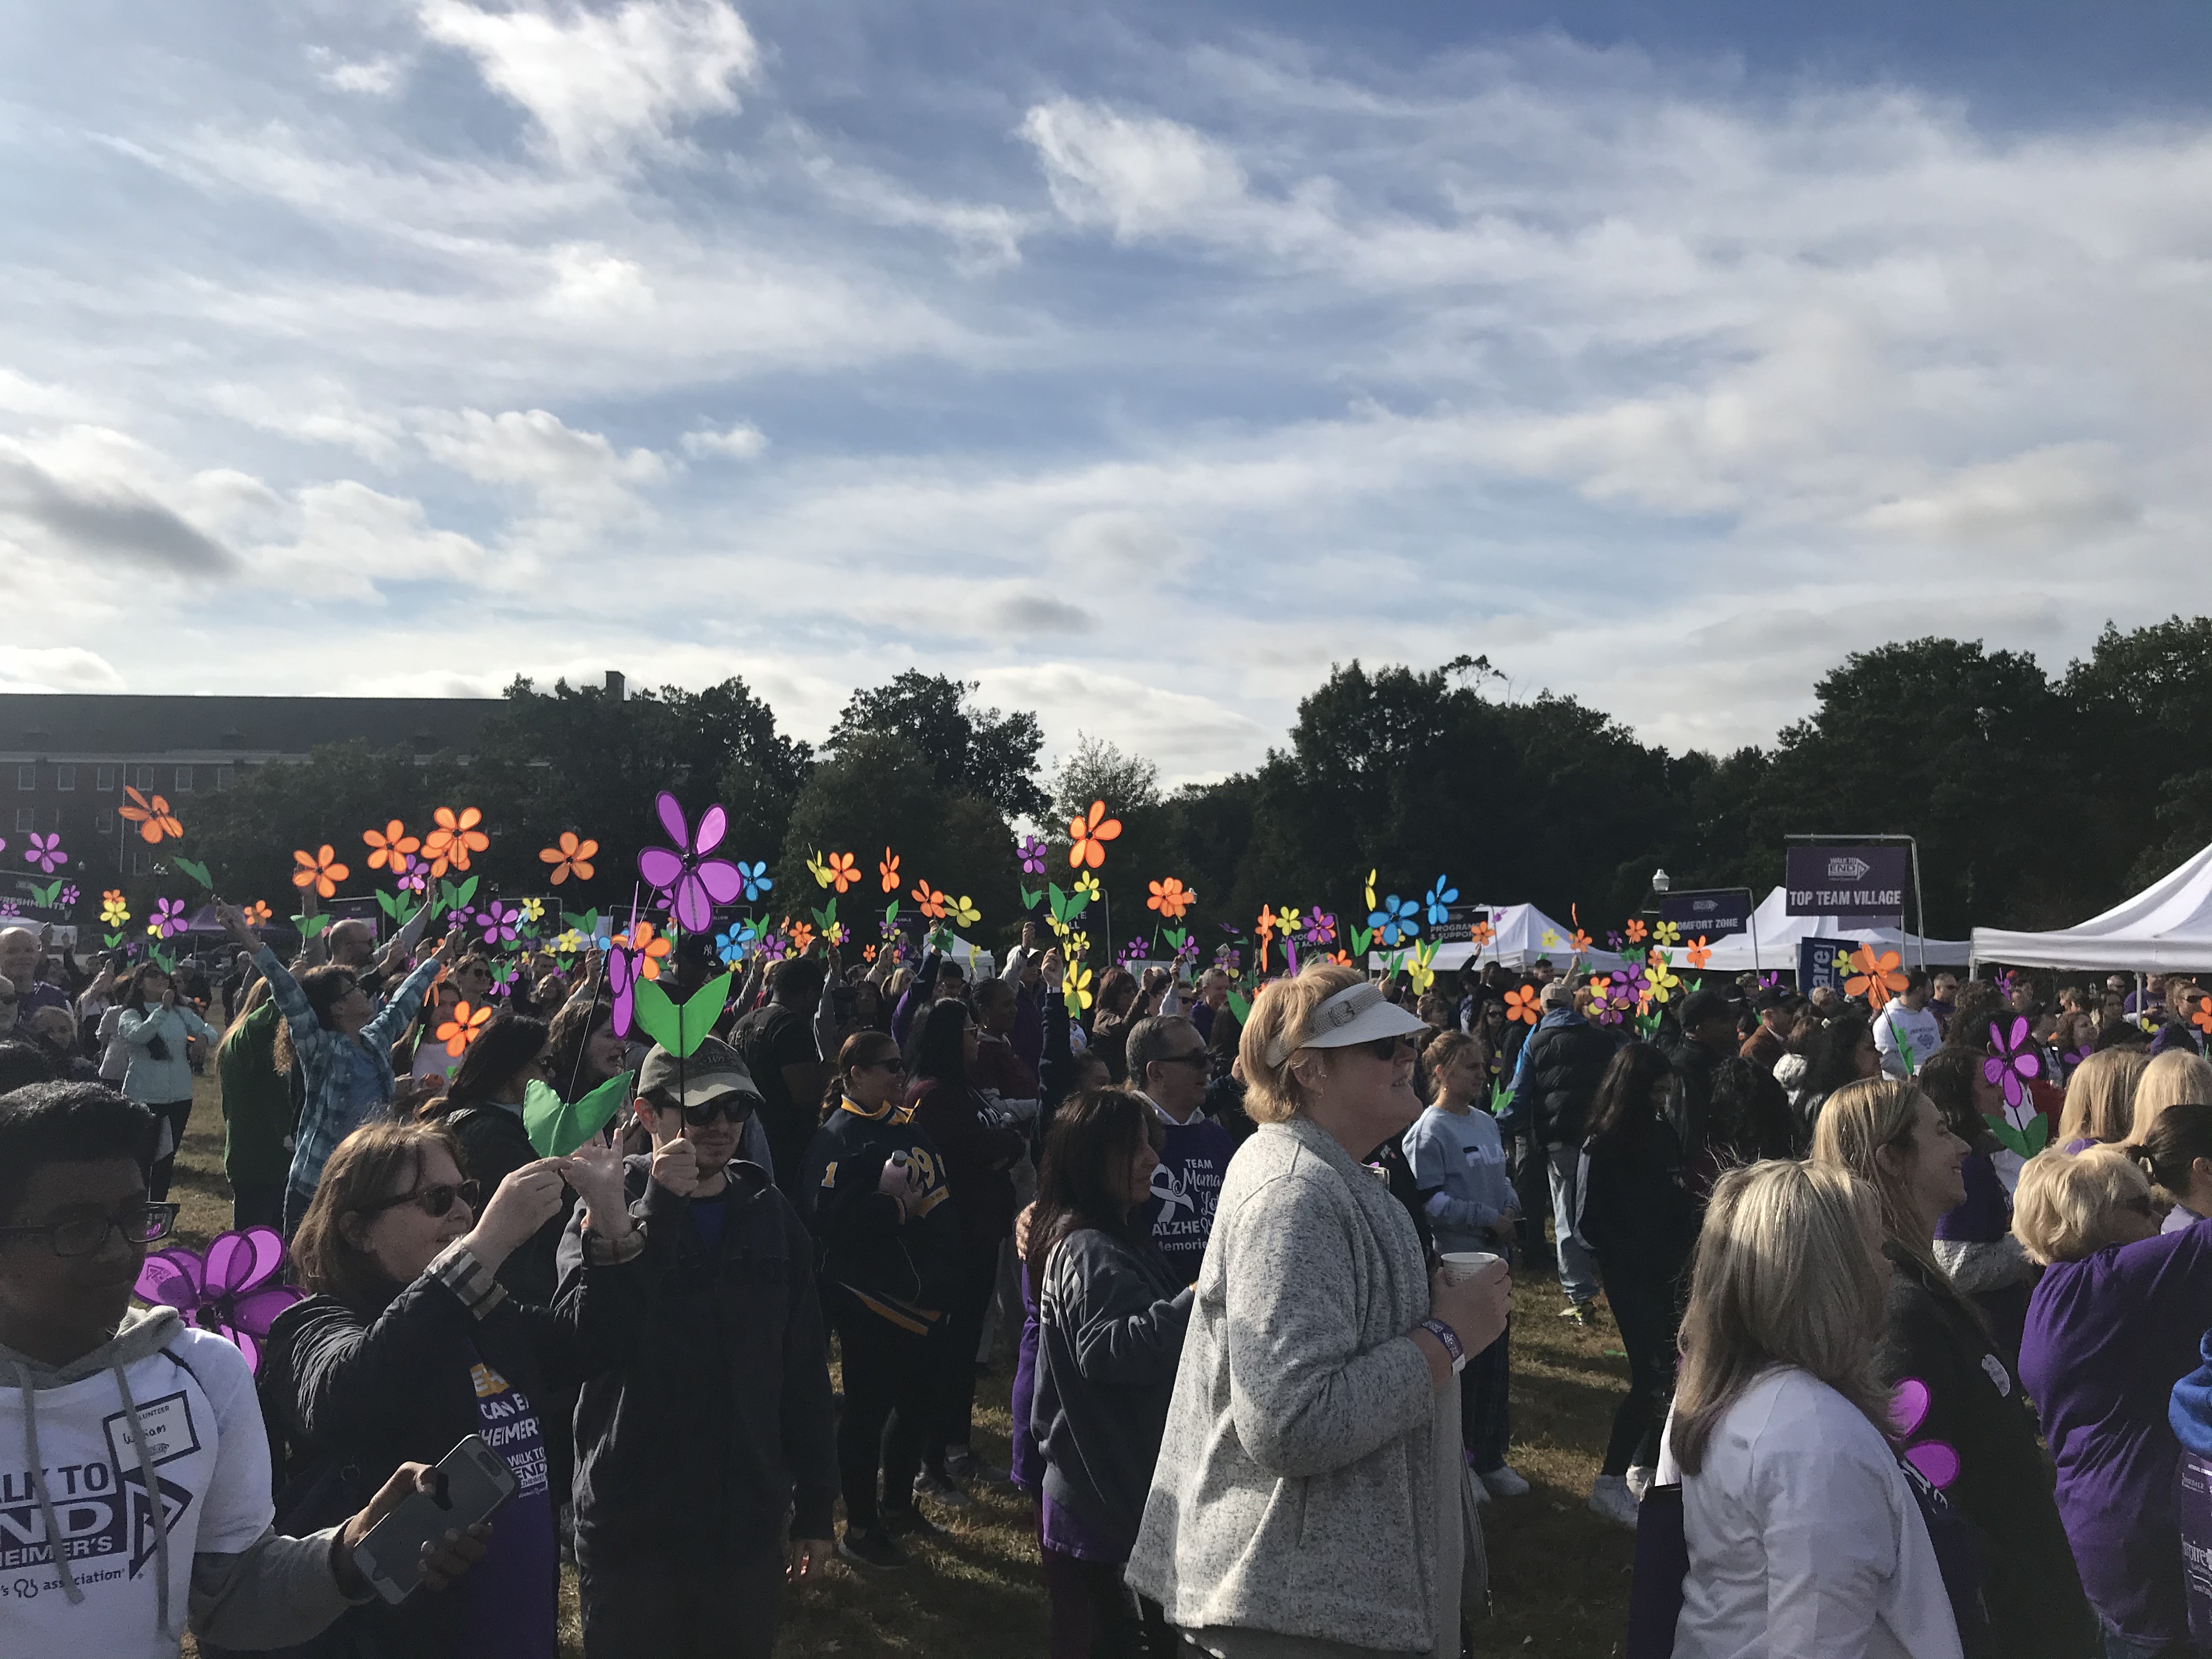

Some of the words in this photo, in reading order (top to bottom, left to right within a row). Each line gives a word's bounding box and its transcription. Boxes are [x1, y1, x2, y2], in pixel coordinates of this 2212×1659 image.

[1790, 891, 1813, 906] TOP
[1816, 890, 1850, 905] TEAM
[1853, 890, 1901, 905] VILLAGE
[1716, 918, 1738, 928] ZONE
[1185, 1159, 1213, 1169] TEAM
[821, 1162, 838, 1188] 1
[138, 1405, 170, 1420] LUNTEER
[58, 1462, 109, 1494] TO
[43, 1570, 122, 1590] assciation
